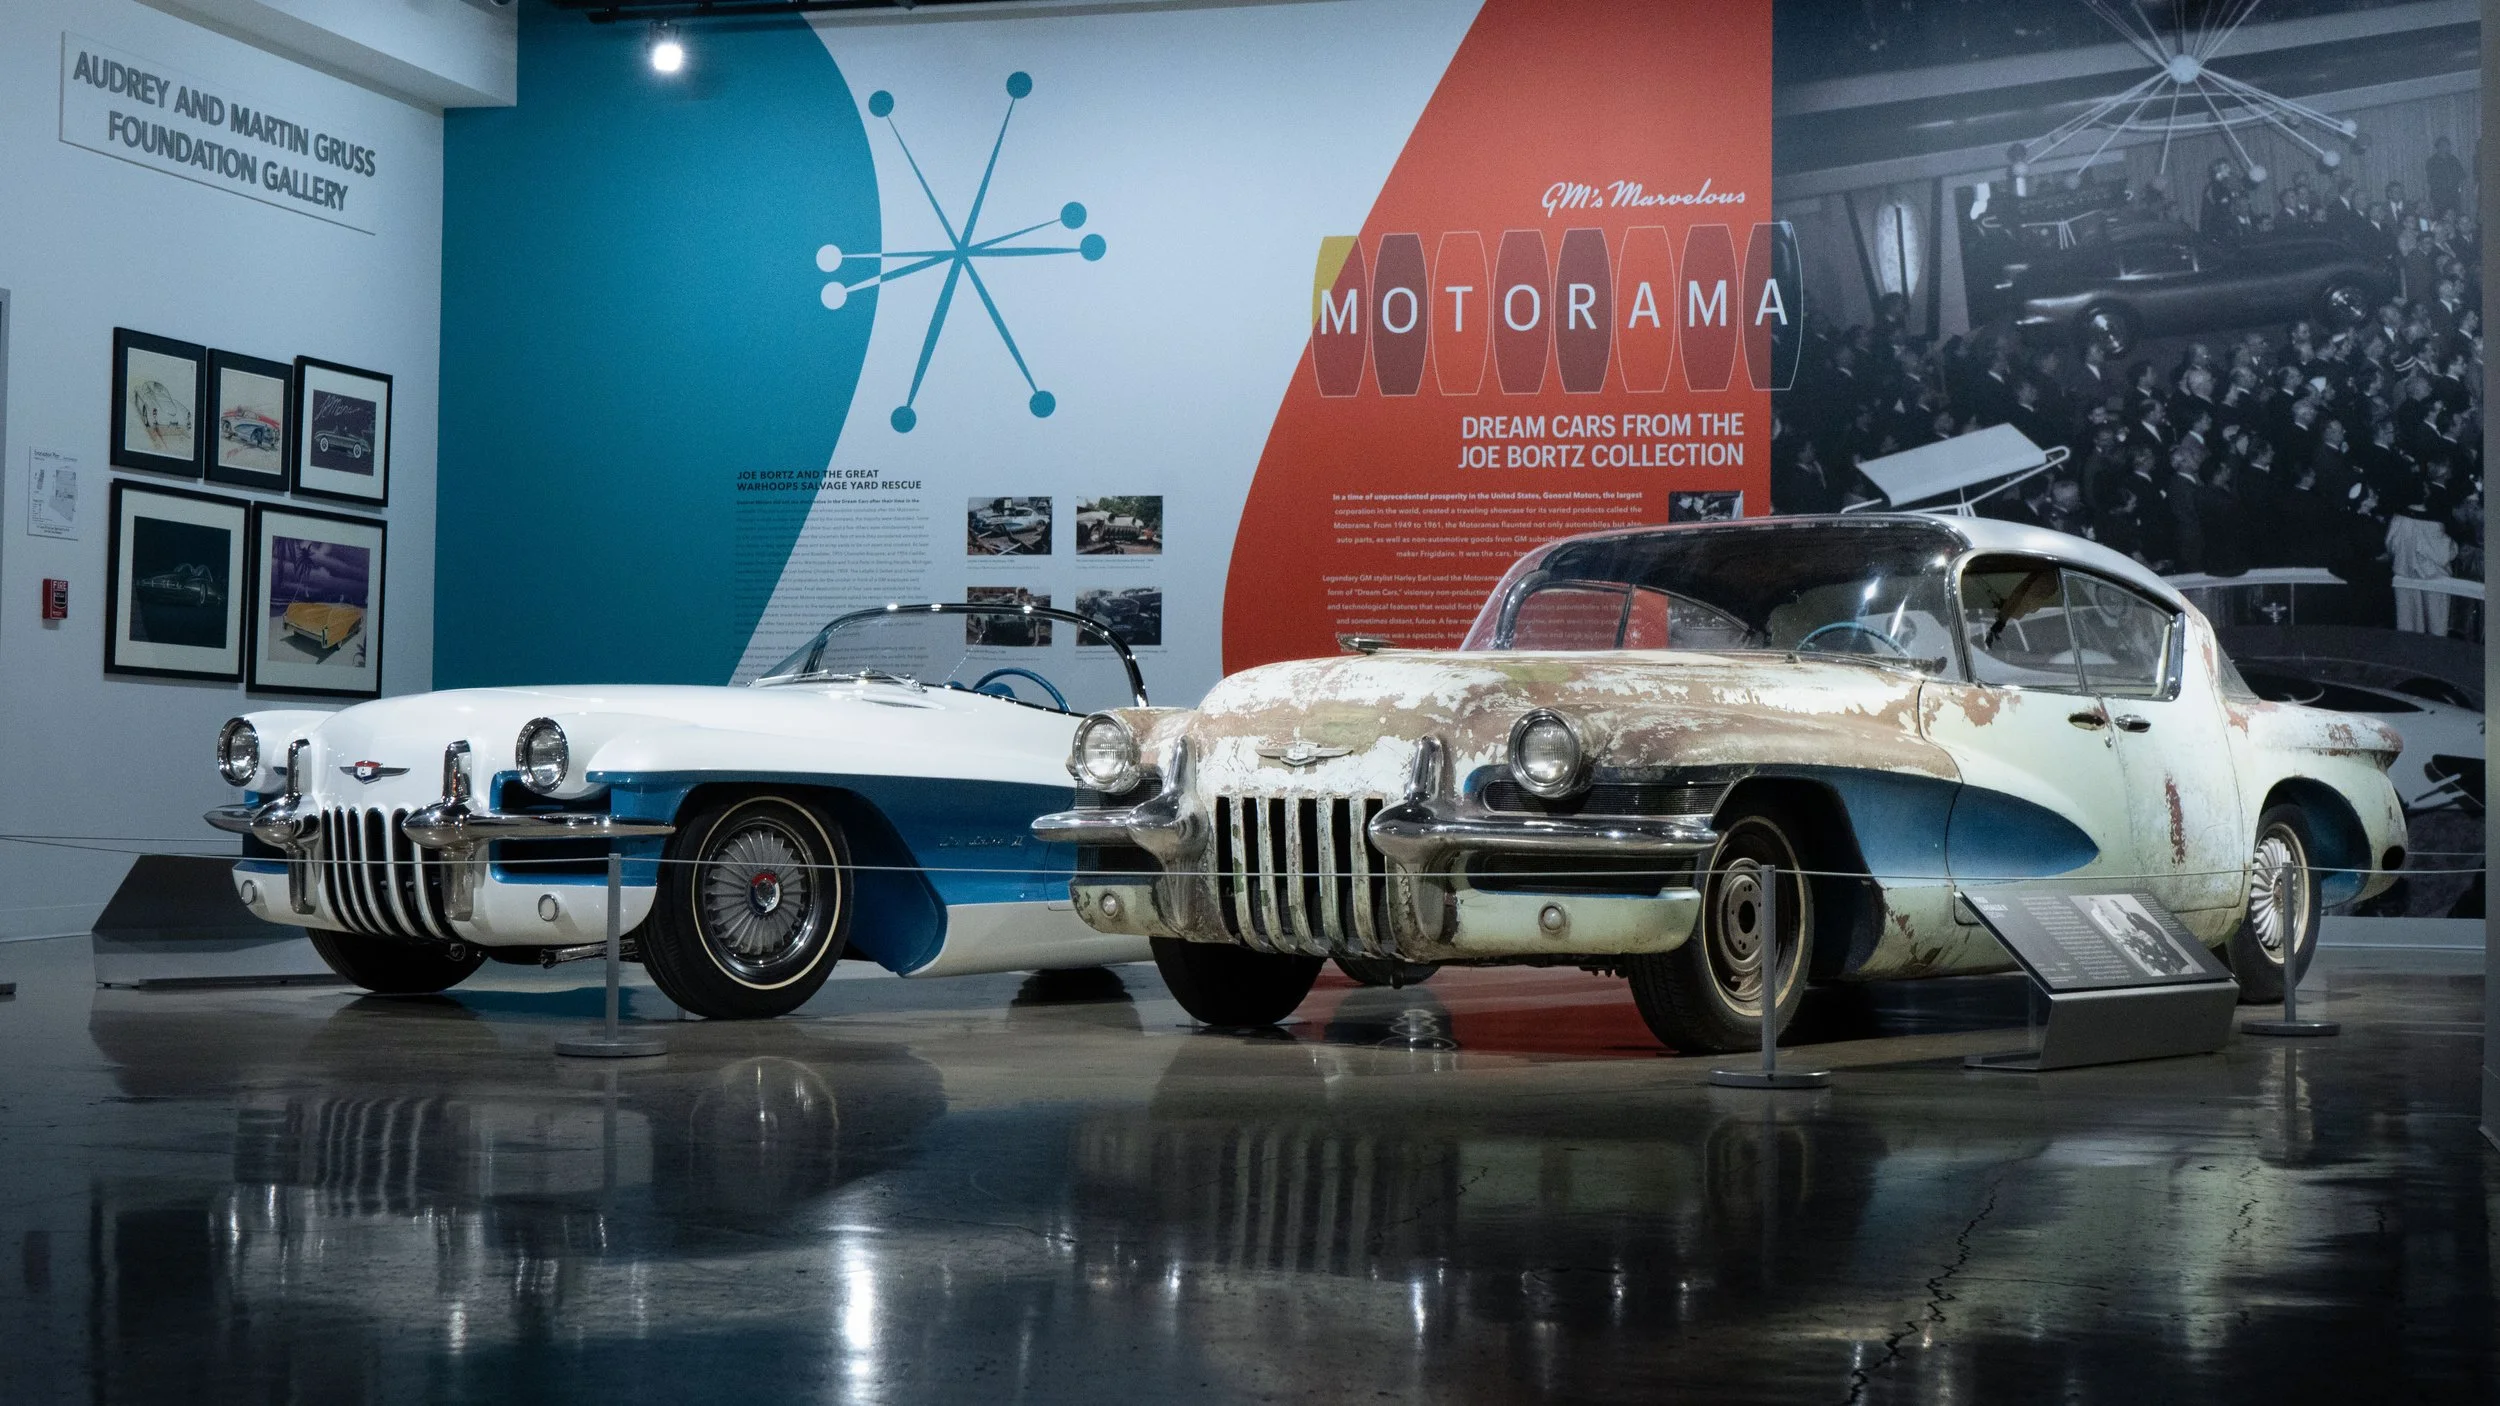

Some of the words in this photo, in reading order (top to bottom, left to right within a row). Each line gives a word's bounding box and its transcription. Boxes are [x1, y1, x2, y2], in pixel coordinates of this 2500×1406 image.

[73, 51, 170, 108] AUDREY
[174, 86, 225, 126] AND
[231, 103, 309, 156] MARTIN
[314, 133, 376, 177] GRUSS
[109, 110, 256, 184] FOUNDATION
[262, 161, 348, 211] GALLERY
[1541, 181, 1603, 218] GM's
[1608, 178, 1746, 207] Marvelous
[1320, 278, 1789, 335] MOTORAMA
[1462, 416, 1545, 439] DREAM
[1552, 415, 1616, 438] CARS
[1622, 414, 1691, 437] FROM
[1698, 413, 1745, 436] THE
[1457, 446, 1500, 469] JOE
[1507, 445, 1585, 468] BORTZ
[1591, 443, 1745, 467] COLLECTION
[736, 471, 757, 480] JOE
[760, 471, 795, 480] BORTZ
[796, 470, 820, 479] AND
[823, 470, 842, 479] THE
[845, 470, 879, 479] GREAT
[736, 482, 798, 491] WARHOOPS
[801, 482, 847, 490] SALVAGE
[851, 481, 878, 490] YARD
[882, 481, 922, 490] RESCUE
[1374, 493, 1428, 501] unprecedented
[1430, 492, 1467, 501] prosperity
[1468, 492, 1476, 500] in
[1476, 492, 1489, 500] the
[1490, 492, 1515, 500] United
[1616, 492, 1642, 500] largest
[1334, 507, 1376, 516] corporation
[1456, 507, 1488, 515] traveling
[1490, 506, 1524, 514] showcase
[1526, 506, 1536, 514] for
[1538, 506, 1546, 514] its
[1548, 506, 1571, 514] varied
[1572, 506, 1605, 515] products
[1564, 520, 1611, 528] automobiles
[53, 580, 67, 589] FIRE
